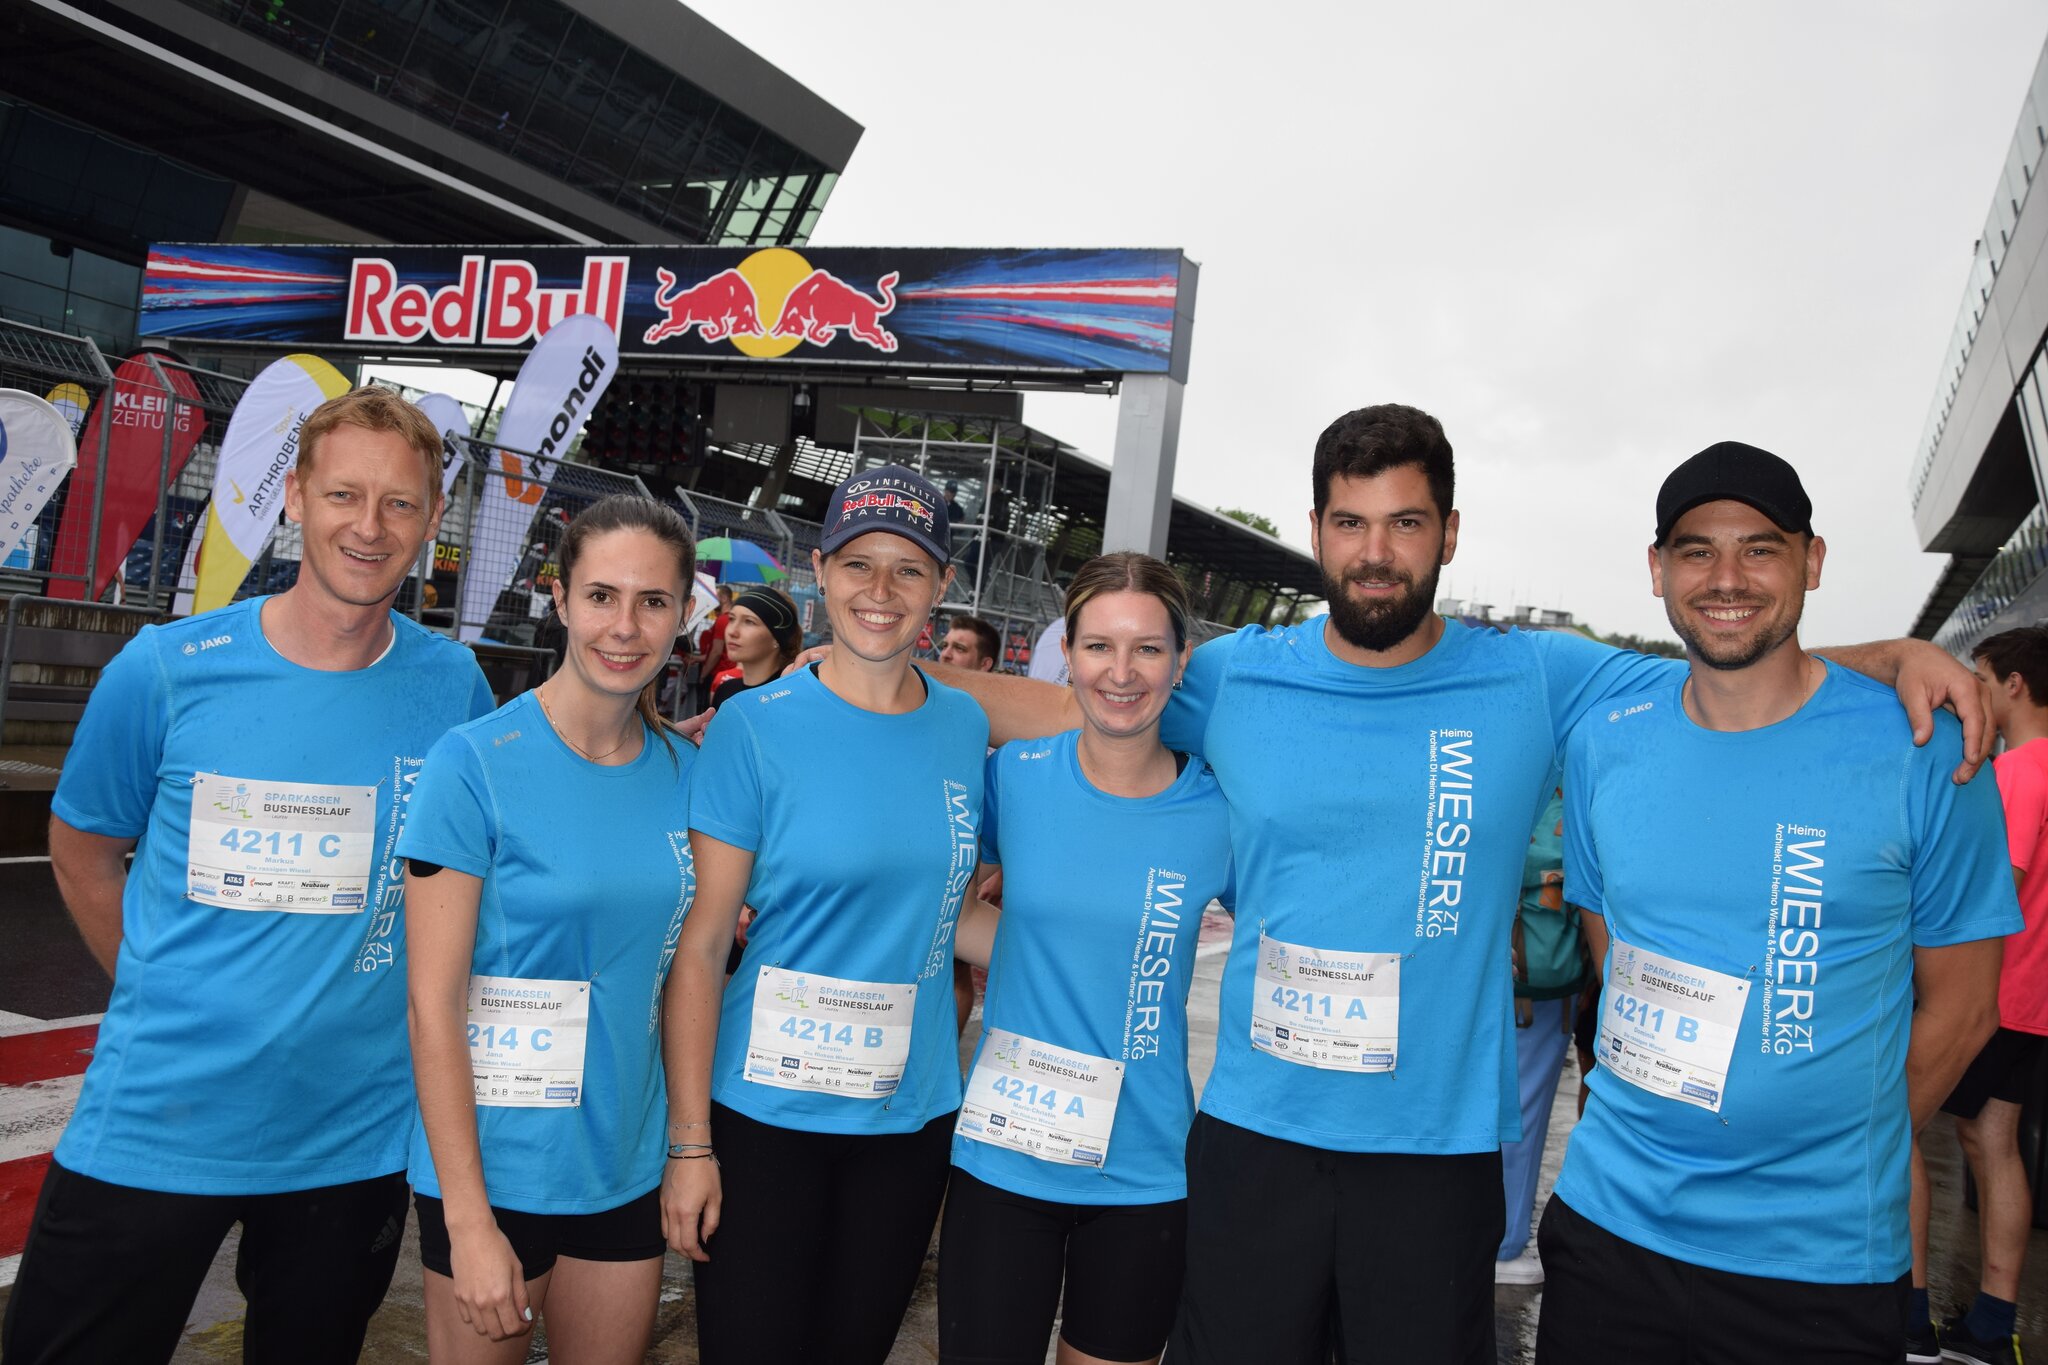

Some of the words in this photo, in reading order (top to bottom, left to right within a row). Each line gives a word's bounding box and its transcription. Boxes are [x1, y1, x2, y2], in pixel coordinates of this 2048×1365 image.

[343, 255, 485, 344] Red
[482, 256, 630, 347] Bull
[528, 344, 606, 479] mondi
[248, 411, 308, 516] ARTHROBENE
[0, 457, 42, 514] potheke
[876, 478, 935, 504] INFINITI
[842, 494, 867, 514] Red
[867, 494, 896, 508] Bull
[843, 508, 933, 533] RACING
[200, 635, 232, 651] JAKO
[770, 689, 792, 700] JAKO
[1624, 702, 1653, 717] JAKO
[1430, 730, 1438, 762] Architekt
[1440, 729, 1473, 738] Heimo
[404, 756, 425, 766] Heim
[1430, 764, 1437, 773] DI
[393, 756, 402, 793] Architekt
[949, 779, 967, 792] Heimo
[1428, 774, 1437, 800] Heimo
[264, 793, 341, 805] SPARKASSEN
[393, 793, 401, 803] DI
[942, 778, 953, 813] Architekt
[263, 804, 351, 816] BUSINESSLAUF
[389, 804, 400, 833] Heimo
[1427, 801, 1436, 831] Wieser
[1429, 740, 1472, 907] WIESER
[1787, 824, 1826, 837] Heimo
[220, 828, 303, 856] 4211
[319, 835, 341, 858] C
[382, 834, 395, 866] Wieser
[1423, 839, 1433, 870] Partner
[1773, 823, 1784, 863] Architekt
[265, 857, 294, 865] Markus
[936, 794, 975, 948] WIESER
[1773, 864, 1781, 875] DI
[226, 876, 242, 884] AT&S
[1144, 867, 1156, 901] Architekt
[1158, 868, 1187, 881] Heimo
[374, 874, 386, 906] Partner
[1417, 871, 1430, 922] Ziviltechniker
[1771, 876, 1781, 906] Heimo
[1144, 902, 1151, 911] DI
[1139, 911, 1150, 936] Heimo
[1415, 924, 1424, 938] KG
[1426, 909, 1443, 938] KG
[1442, 911, 1459, 935] ZT
[1768, 907, 1778, 939] Wieser
[1776, 840, 1825, 1020] WIESER
[376, 942, 393, 966] ZT
[1133, 937, 1145, 962] Wieser
[1768, 939, 1776, 947] &
[363, 943, 377, 972] KG
[1133, 883, 1184, 1032] WIESER
[1298, 956, 1364, 971] SPARKASSEN
[1765, 947, 1776, 978] Partner
[1127, 971, 1138, 998] Partner
[1298, 966, 1374, 982] BUSINESSLAUF
[1643, 963, 1706, 989] SPARKASSEN
[482, 987, 551, 999] SPARKASSEN
[819, 986, 885, 1001] SPARKASSEN
[1641, 974, 1716, 1003] BUSINESSLAUF
[481, 998, 562, 1010] BUSINESSLAUF
[818, 997, 894, 1011] BUSINESSLAUF
[1271, 986, 1331, 1017] 4211
[1345, 998, 1367, 1020] A
[1761, 979, 1774, 1037] Ziviltechniker
[1123, 999, 1136, 1047] Ziviltechniker
[1614, 993, 1665, 1033] 4211
[1675, 1015, 1700, 1044] B
[467, 1023, 518, 1050] 214
[530, 1028, 553, 1052] C
[779, 1017, 853, 1046] 4214
[864, 1027, 883, 1048] B
[1146, 1034, 1159, 1056] ZT
[1774, 1023, 1793, 1056] KG
[1794, 1025, 1813, 1053] ZT
[817, 1044, 843, 1053] Kerstin
[1122, 1048, 1129, 1060] KG
[1131, 1034, 1146, 1060] KG
[1760, 1039, 1771, 1054] KG
[1028, 1058, 1098, 1083] BUSINESSLAUF
[1030, 1049, 1090, 1071] SPARKASSEN
[992, 1075, 1057, 1110] 4214
[1064, 1096, 1085, 1118] A
